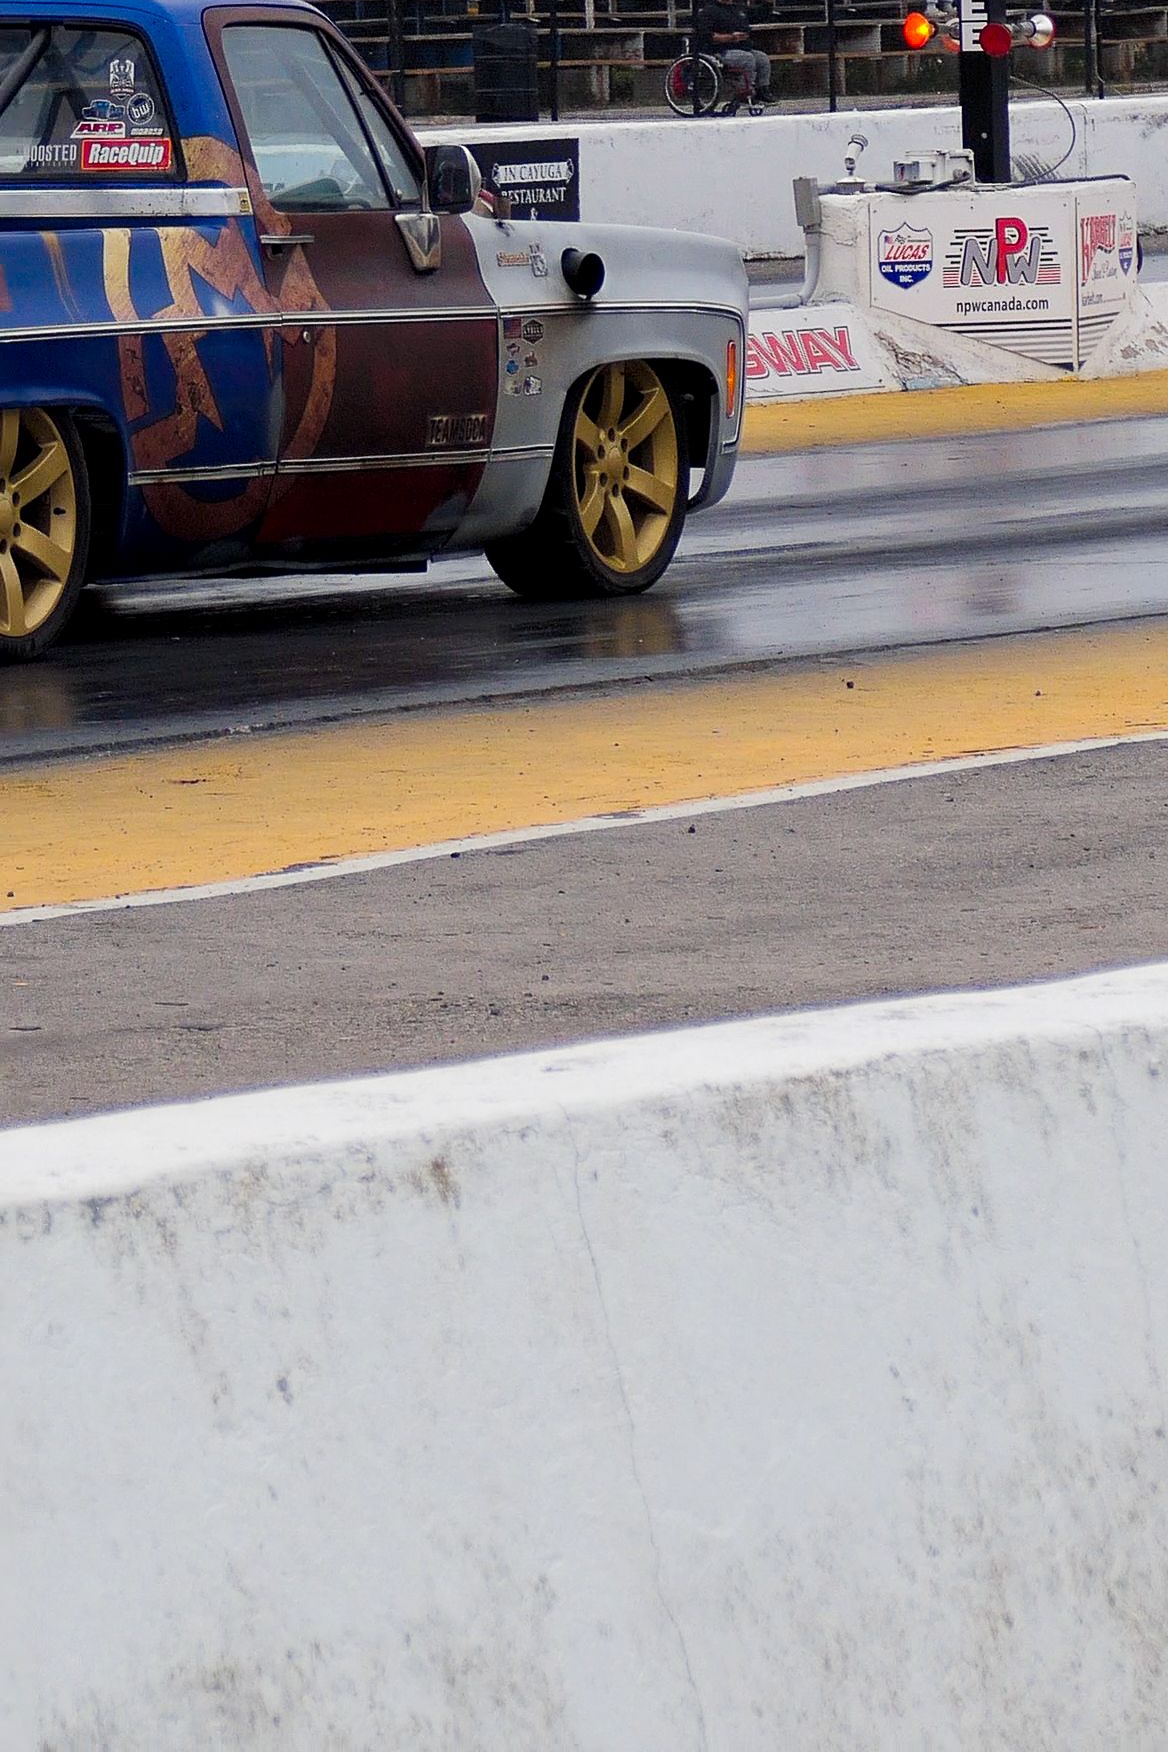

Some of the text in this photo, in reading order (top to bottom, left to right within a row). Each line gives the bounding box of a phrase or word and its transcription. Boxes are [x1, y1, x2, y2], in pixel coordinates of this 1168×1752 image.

[77, 123, 123, 132] ARP
[88, 143, 165, 165] RaceQuip
[504, 164, 563, 181] IN CAYUGA
[884, 244, 930, 260] LUCAS
[960, 218, 1041, 285] NPW
[882, 264, 931, 273] OIL PRODUCTS
[957, 297, 1049, 315] npwcanada.com
